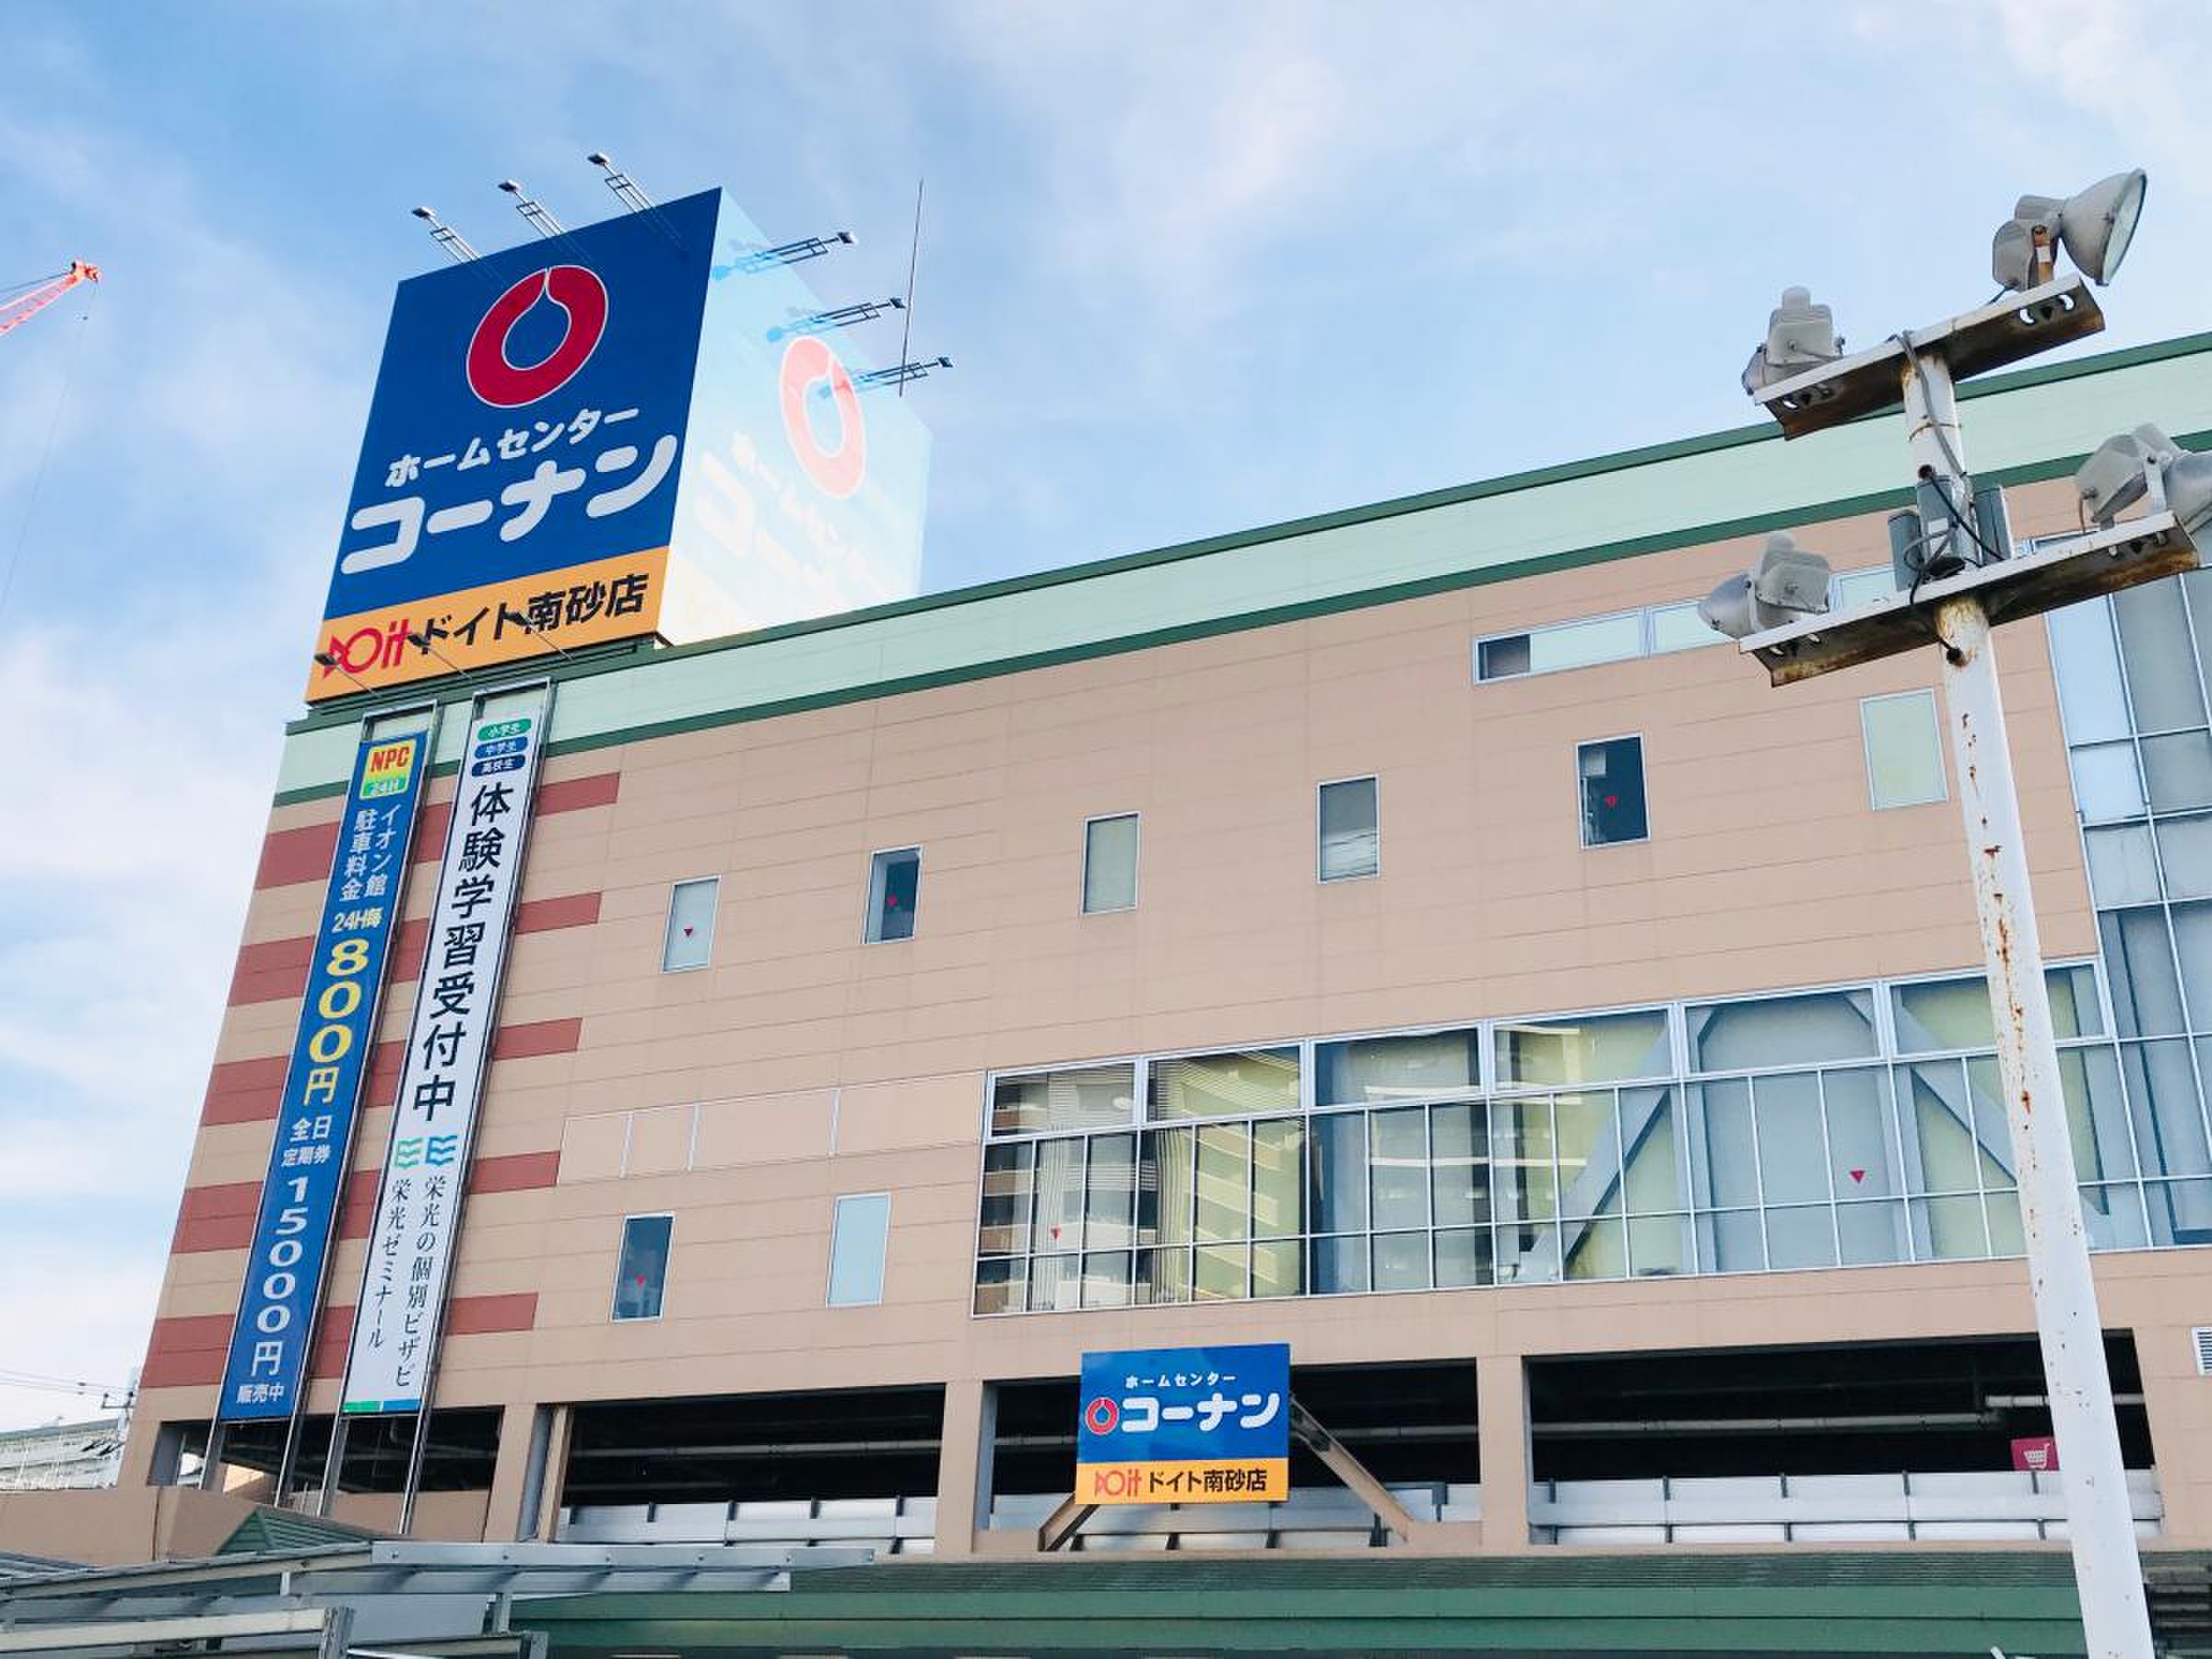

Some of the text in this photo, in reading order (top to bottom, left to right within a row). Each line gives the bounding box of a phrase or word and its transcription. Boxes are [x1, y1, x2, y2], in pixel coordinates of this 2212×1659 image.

[384, 406, 640, 488] ホームセンター
[340, 434, 677, 575] コーナン
[420, 572, 650, 655] ドイト南砂店
[371, 745, 411, 773] NPC
[339, 808, 378, 901] 駐車料金
[364, 804, 402, 898] イオン館
[412, 782, 514, 1122] 体験学習受付中
[302, 938, 370, 1105] 800円
[280, 1144, 331, 1168] 定期券
[289, 1115, 332, 1142] 全日
[251, 1177, 308, 1377] 15000円
[368, 1178, 413, 1349] 栄光ゼミナール
[395, 1175, 446, 1388] 栄光の個別ビザビ
[235, 1382, 285, 1404] 販売中
[1121, 1393, 1281, 1433] コーナン
[1124, 1371, 1237, 1389] ホームセンター
[1148, 1467, 1268, 1494] ドイト南砂店
